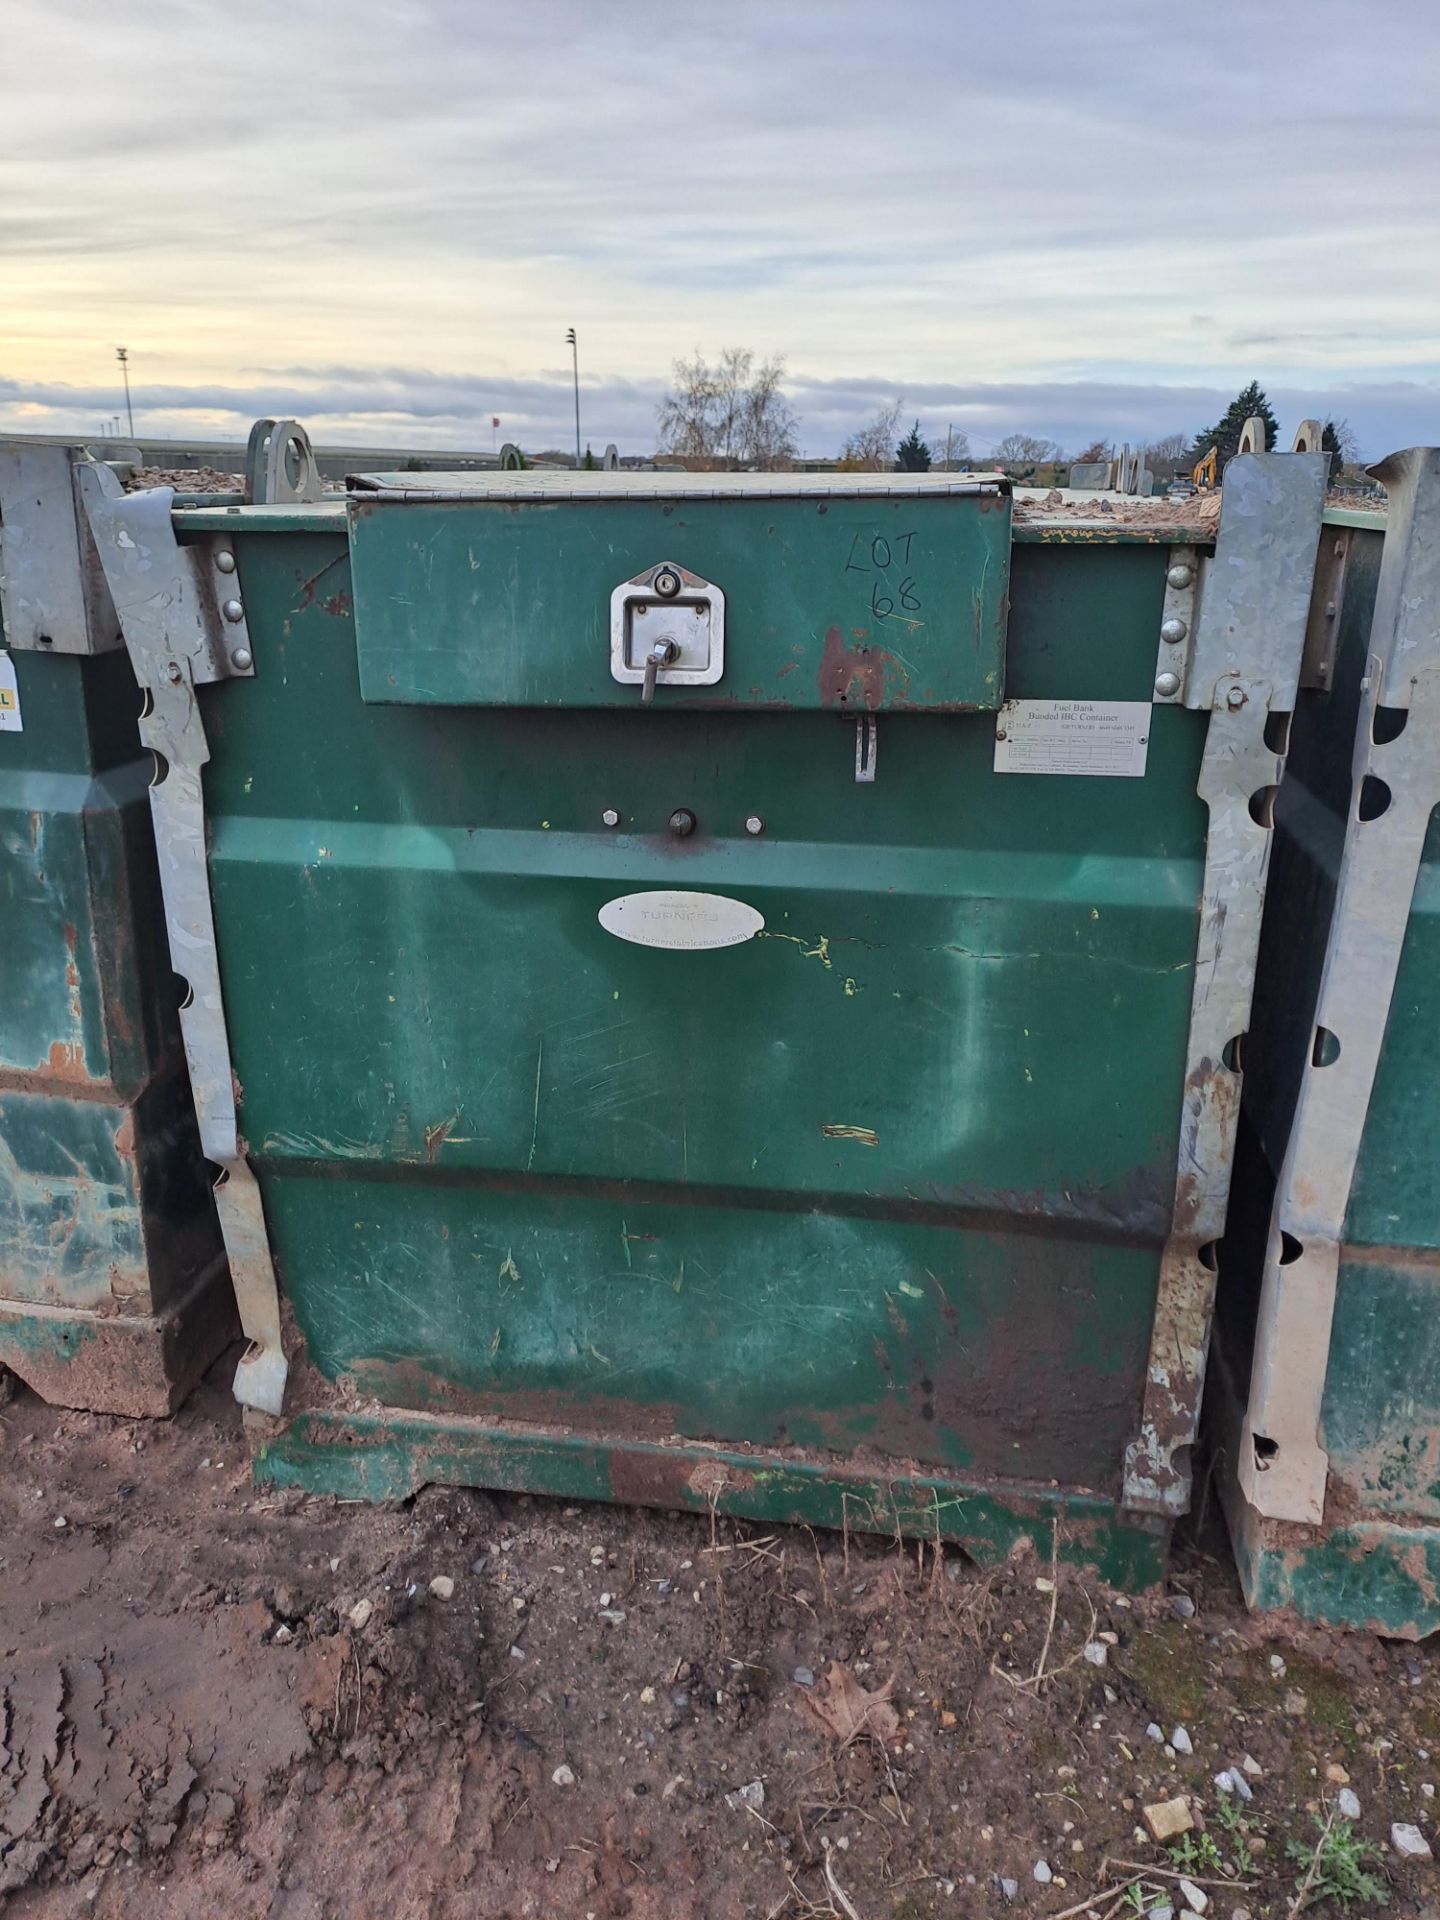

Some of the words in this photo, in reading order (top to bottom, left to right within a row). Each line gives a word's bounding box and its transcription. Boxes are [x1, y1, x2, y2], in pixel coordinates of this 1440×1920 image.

[845, 531, 919, 573] LOT
[872, 576, 922, 619] 68
[1028, 712, 1059, 721] Bunded
[1061, 712, 1078, 721] IBC
[1079, 713, 1119, 722] Container
[1053, 703, 1071, 712] Fuel
[1073, 704, 1094, 712] Bank
